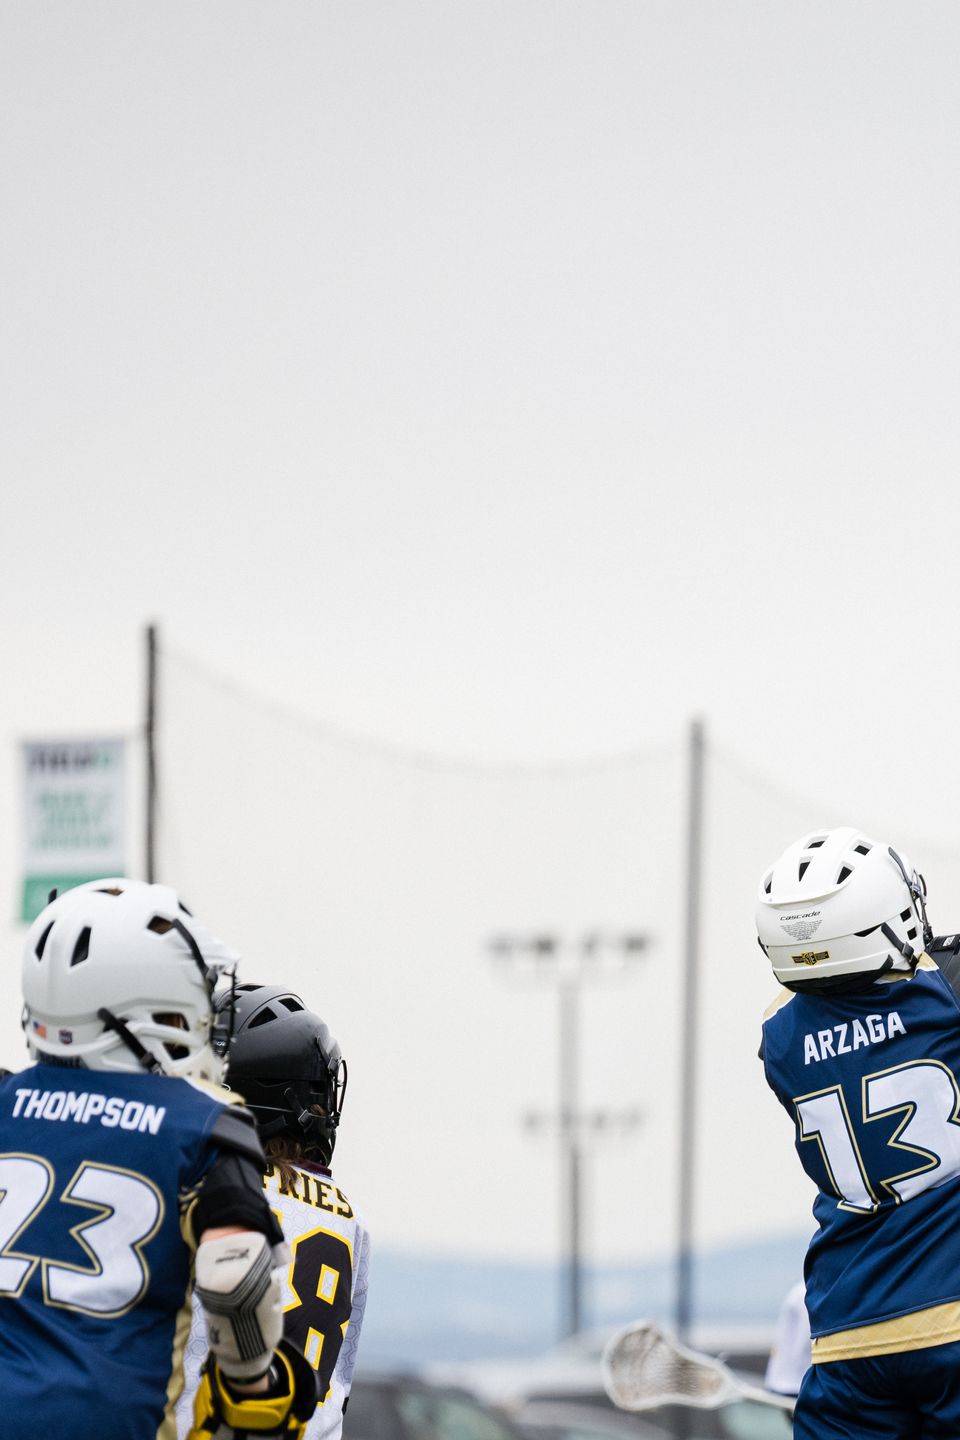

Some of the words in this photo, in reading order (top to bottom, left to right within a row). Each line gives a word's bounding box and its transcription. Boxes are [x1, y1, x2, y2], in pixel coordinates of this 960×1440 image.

[780, 911, 821, 921] cascade
[804, 1012, 907, 1065] ARZAGA
[12, 1088, 166, 1135] THOMPSON
[276, 1224, 352, 1406] 8
